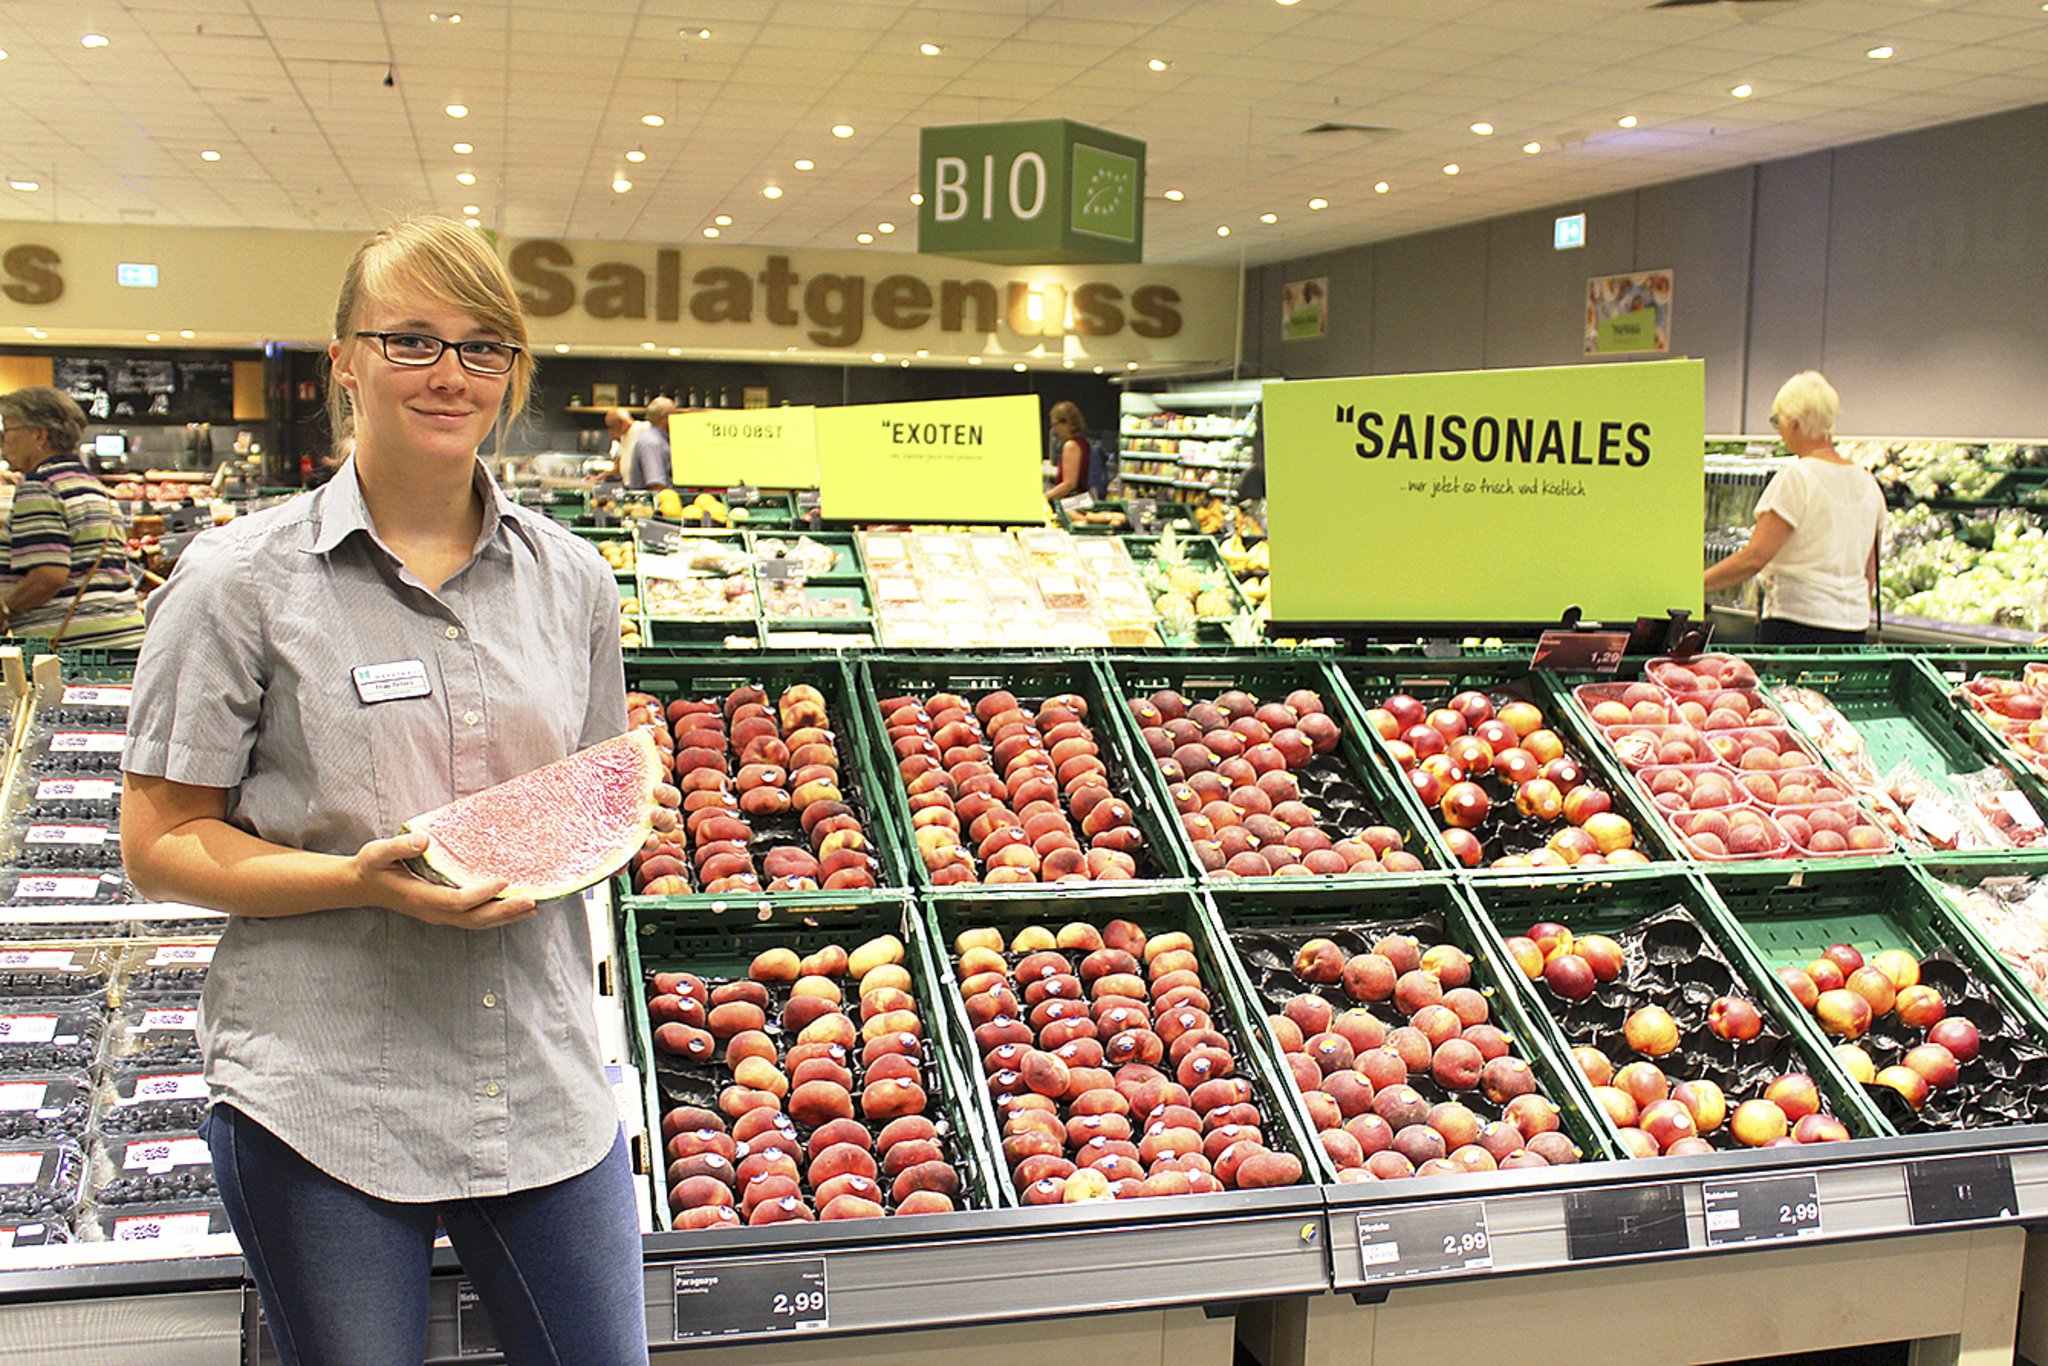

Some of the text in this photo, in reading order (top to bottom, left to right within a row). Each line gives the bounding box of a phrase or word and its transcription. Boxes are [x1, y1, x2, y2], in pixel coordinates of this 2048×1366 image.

[934, 151, 1047, 222] BIO
[508, 239, 1183, 348] Salatgenuss
[742, 423, 783, 440] OBST
[1463, 481, 1477, 493] so
[1480, 477, 1514, 494] frisch
[1779, 1202, 1818, 1225] 2,99
[1443, 1231, 1488, 1256] 2,99
[772, 1290, 824, 1317] 2,99
